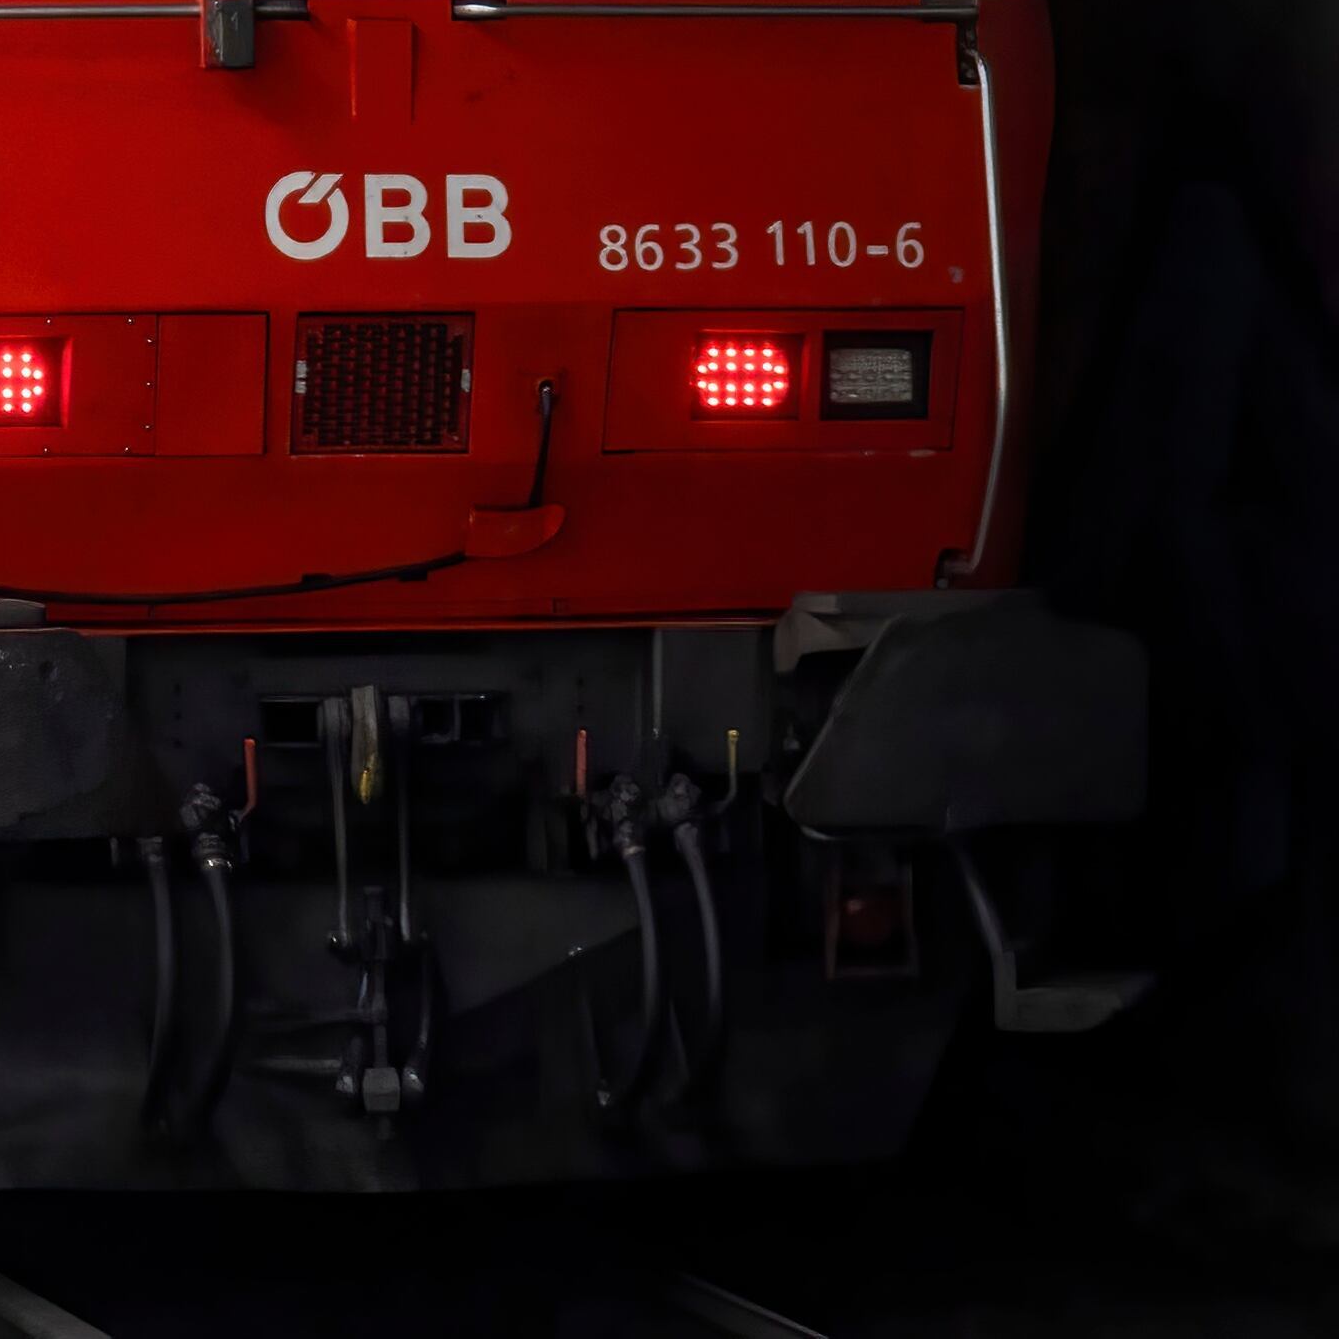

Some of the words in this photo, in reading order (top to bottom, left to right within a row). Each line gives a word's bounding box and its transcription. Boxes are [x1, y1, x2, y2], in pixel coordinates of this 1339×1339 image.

[265, 170, 512, 261] ÖBB
[598, 222, 739, 272] 8633
[766, 220, 925, 268] 110-6
